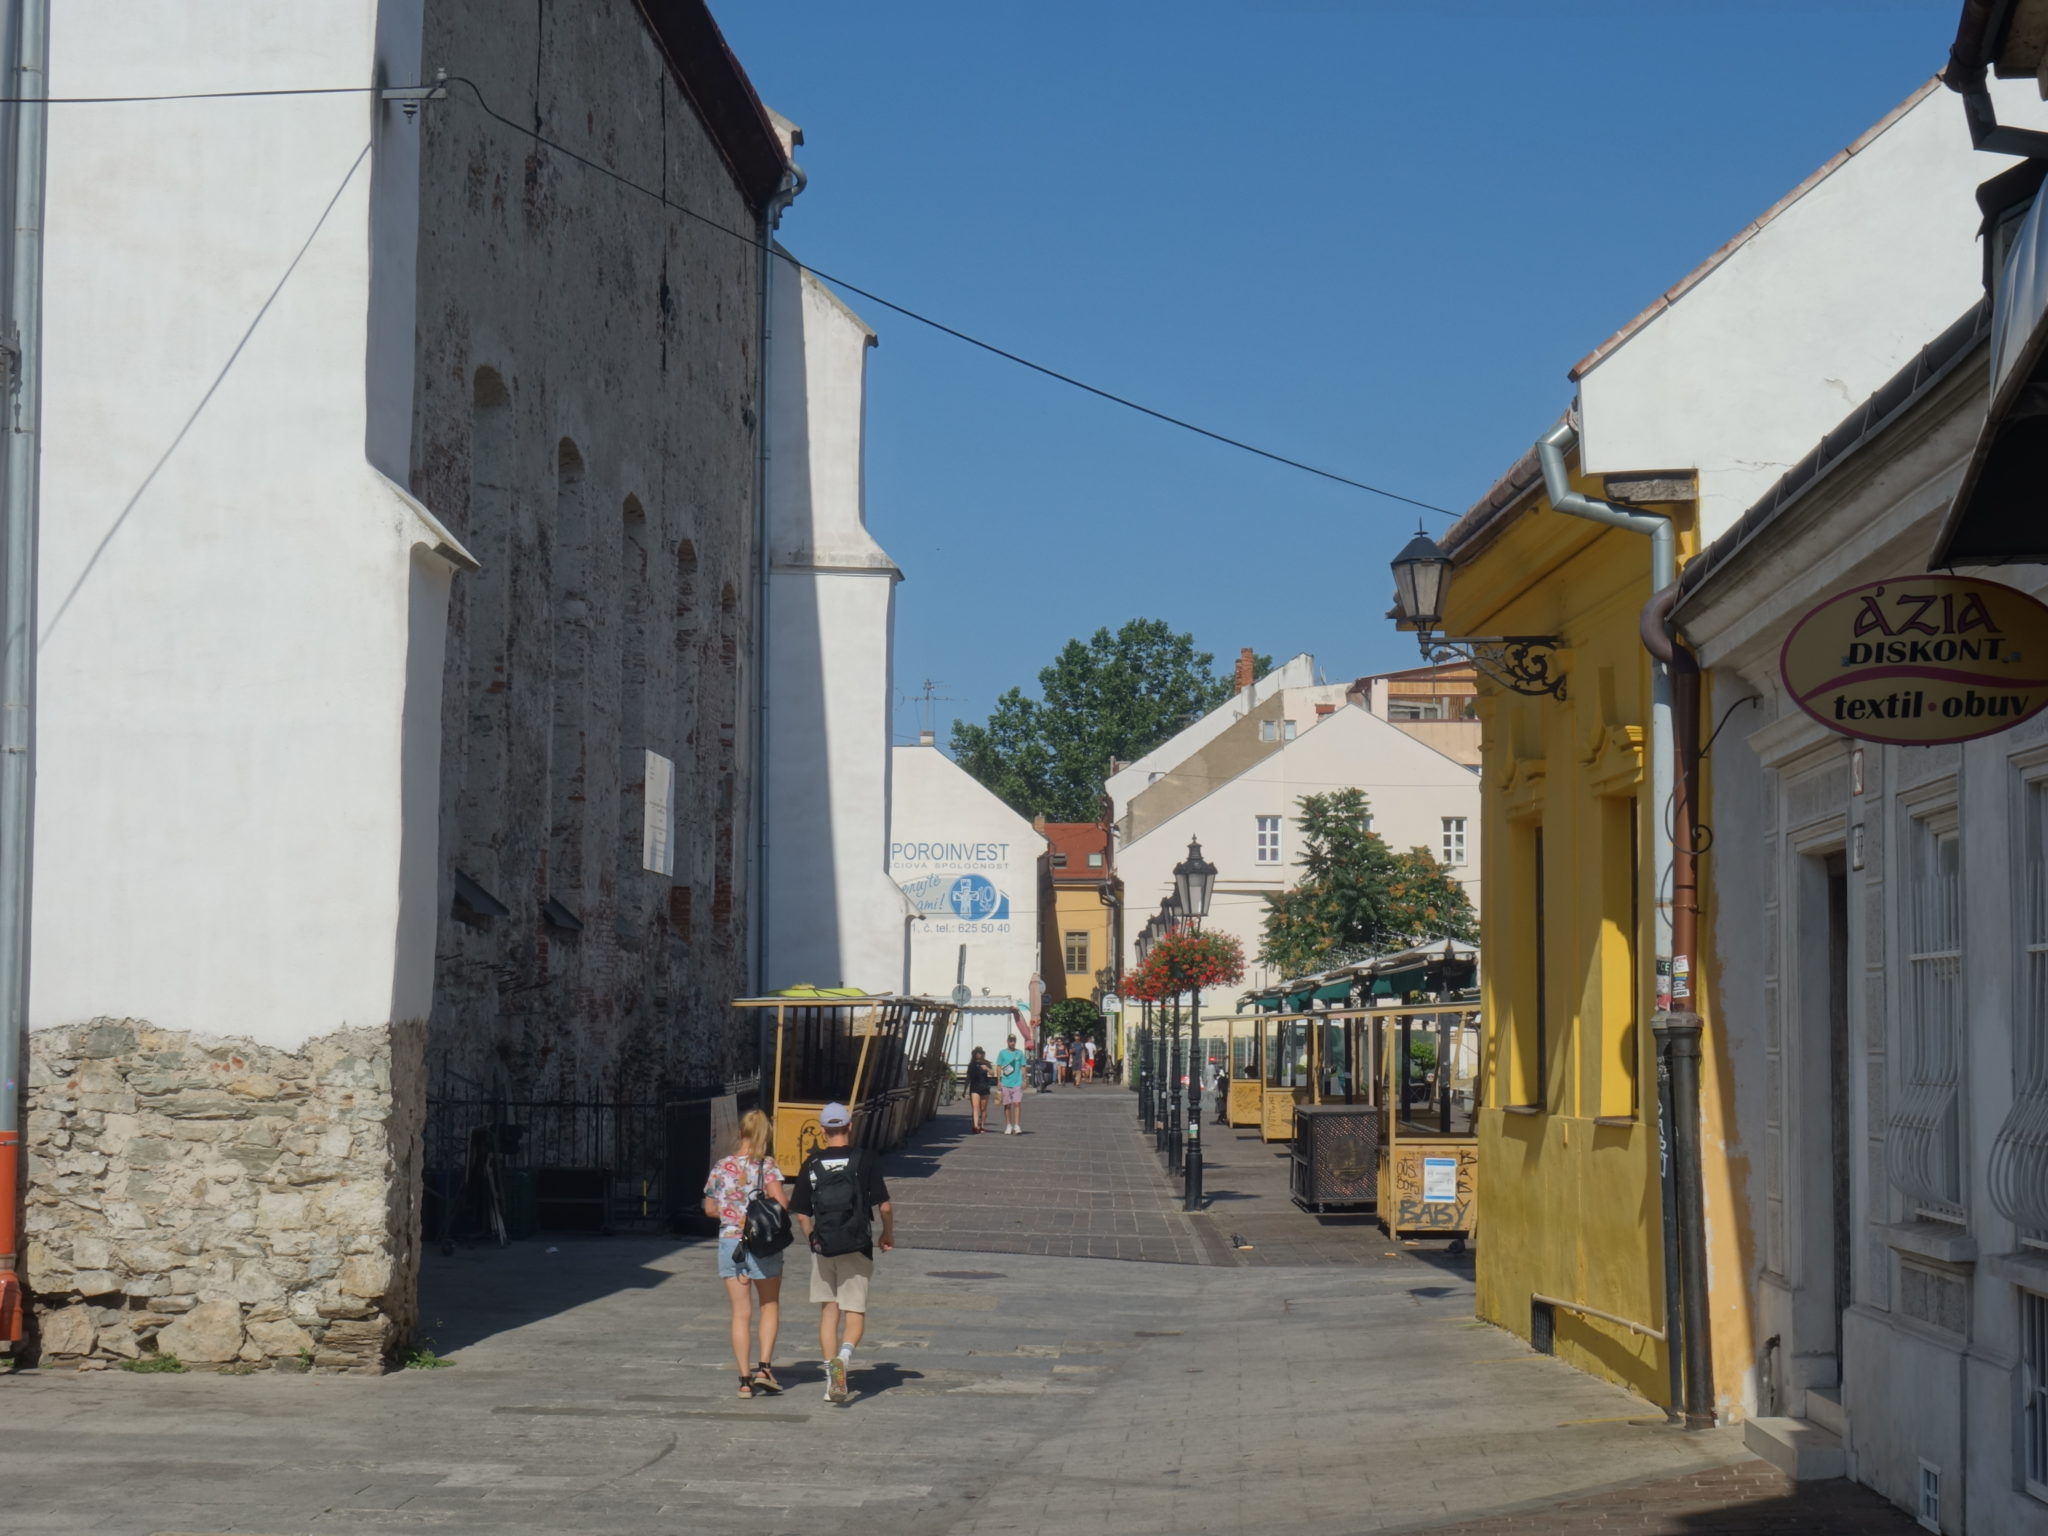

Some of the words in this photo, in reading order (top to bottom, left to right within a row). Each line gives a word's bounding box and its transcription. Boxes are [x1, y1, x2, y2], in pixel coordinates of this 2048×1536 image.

[1854, 586, 2003, 638] ÁZIA
[1848, 638, 2007, 665] DISKONT
[1834, 691, 1923, 720] textil
[1942, 690, 2030, 718] obuv
[891, 843, 1010, 861] POROINVEST
[958, 923, 978, 933] 625
[980, 923, 994, 933] 50
[996, 923, 1011, 933] 40
[1397, 1200, 1468, 1230] BABY
